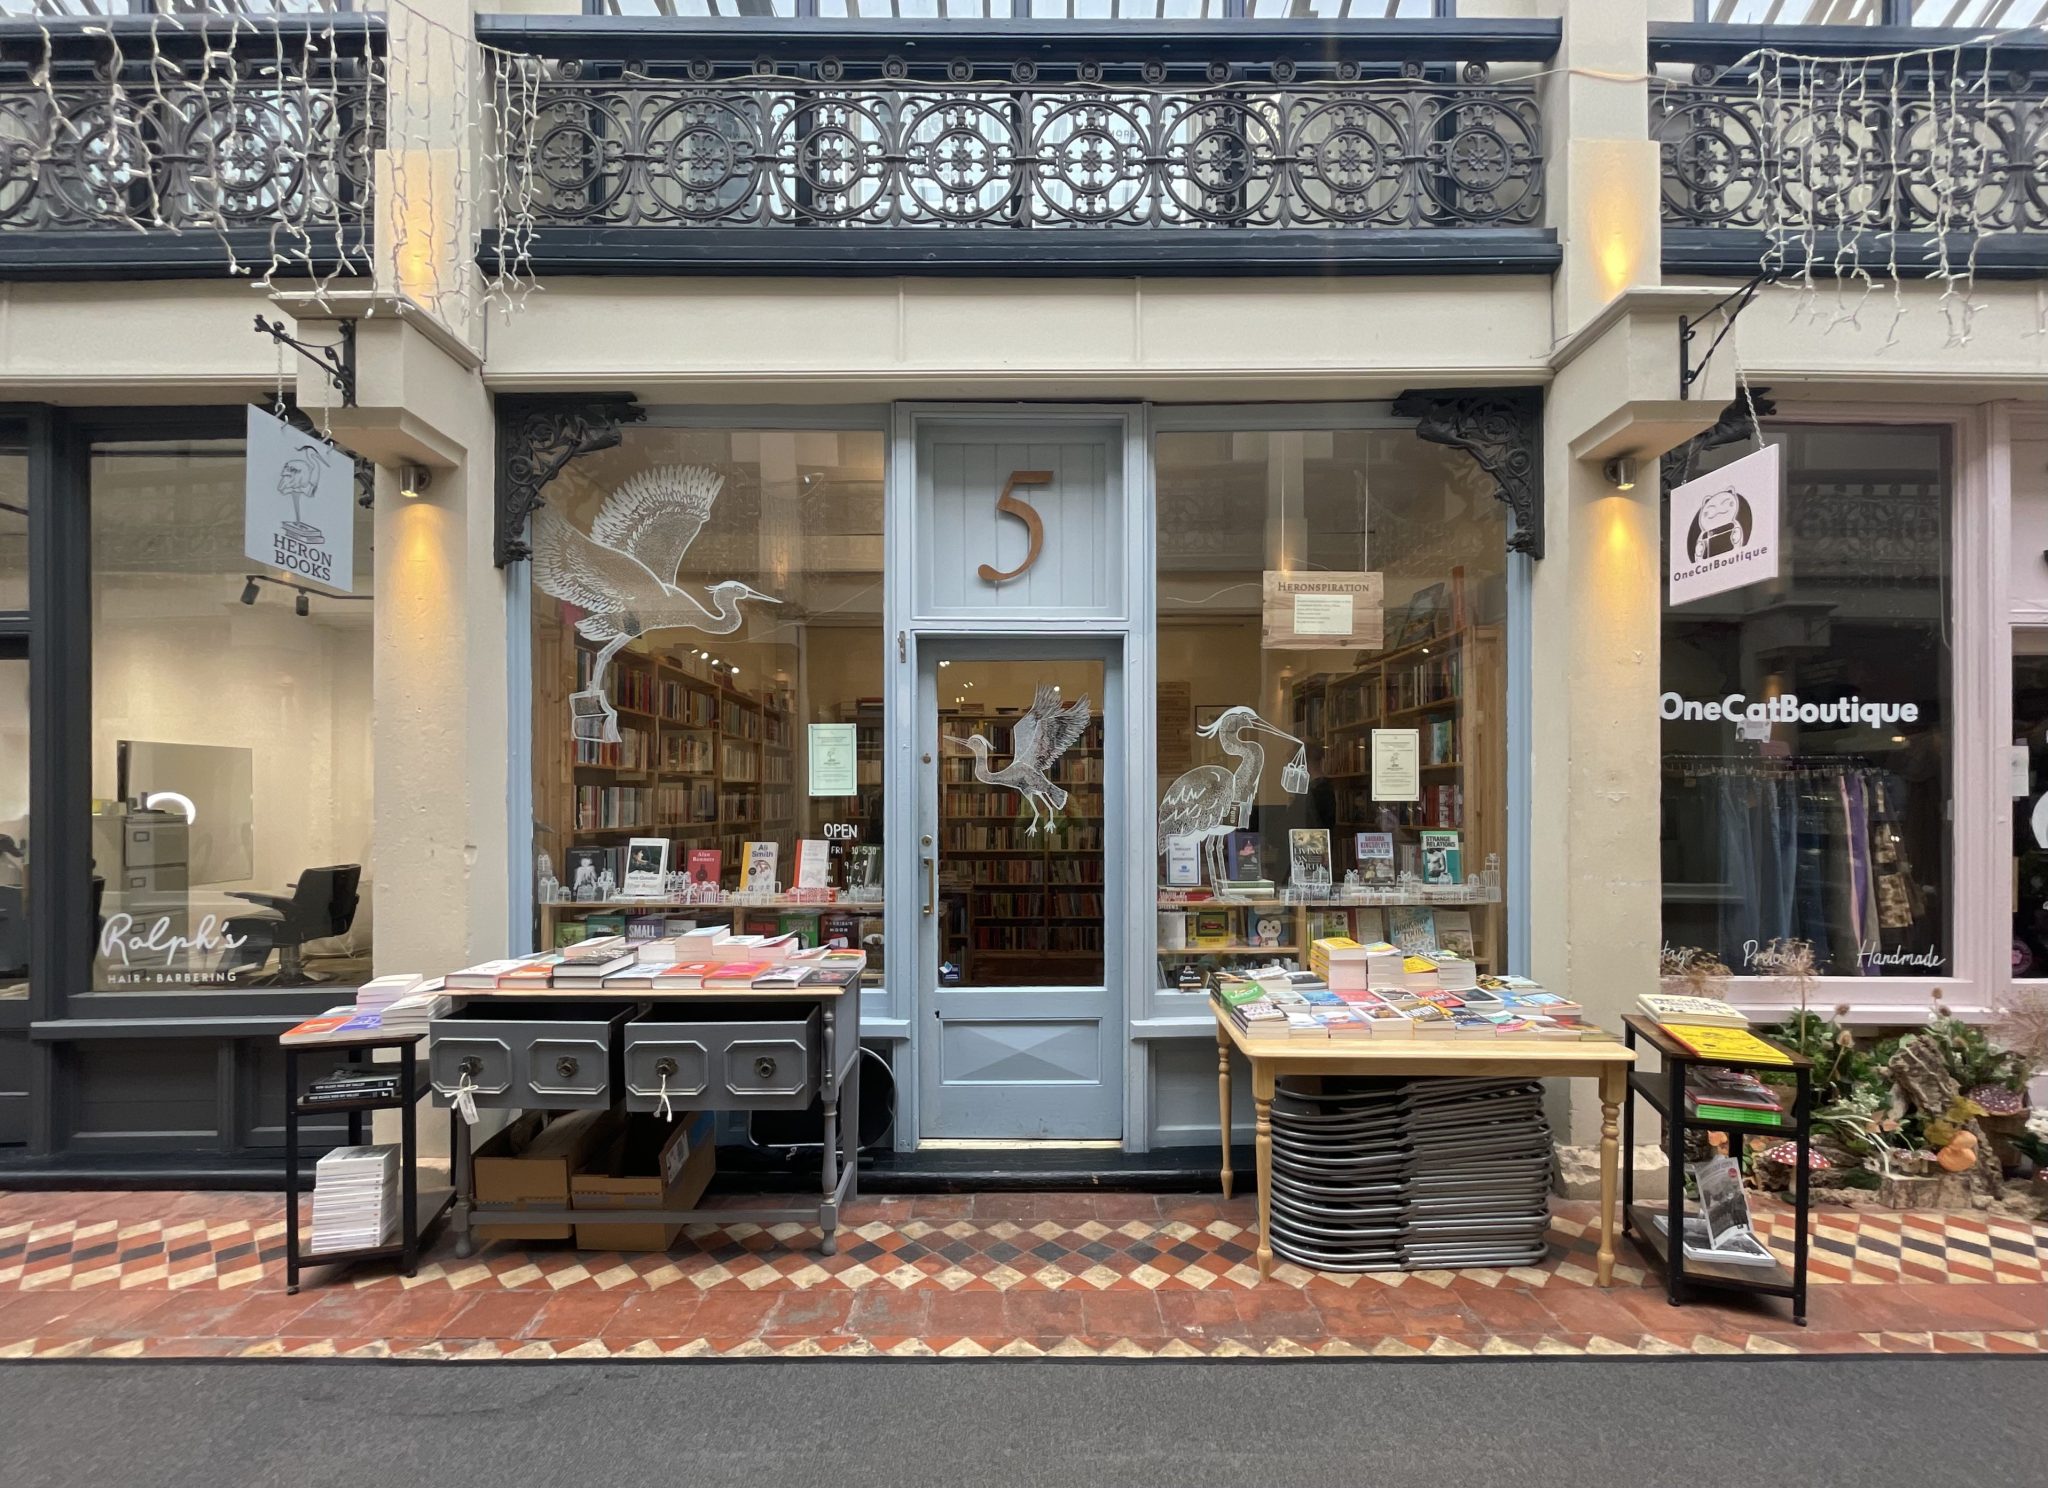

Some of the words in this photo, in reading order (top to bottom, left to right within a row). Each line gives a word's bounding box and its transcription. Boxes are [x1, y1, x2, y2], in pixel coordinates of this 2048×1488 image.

[977, 470, 1054, 582] 5
[273, 533, 333, 567] HERON
[275, 549, 331, 581] BOOKS
[1673, 546, 1768, 582] OneCatBoutique
[1659, 692, 1919, 729] OneCatBoutique
[823, 823, 858, 838] OPEN
[101, 913, 248, 967] Ralph's
[629, 924, 657, 938] SMALL
[1857, 940, 1947, 968] Handmade
[107, 974, 141, 984] HAIR
[156, 972, 237, 983] BARBERING
